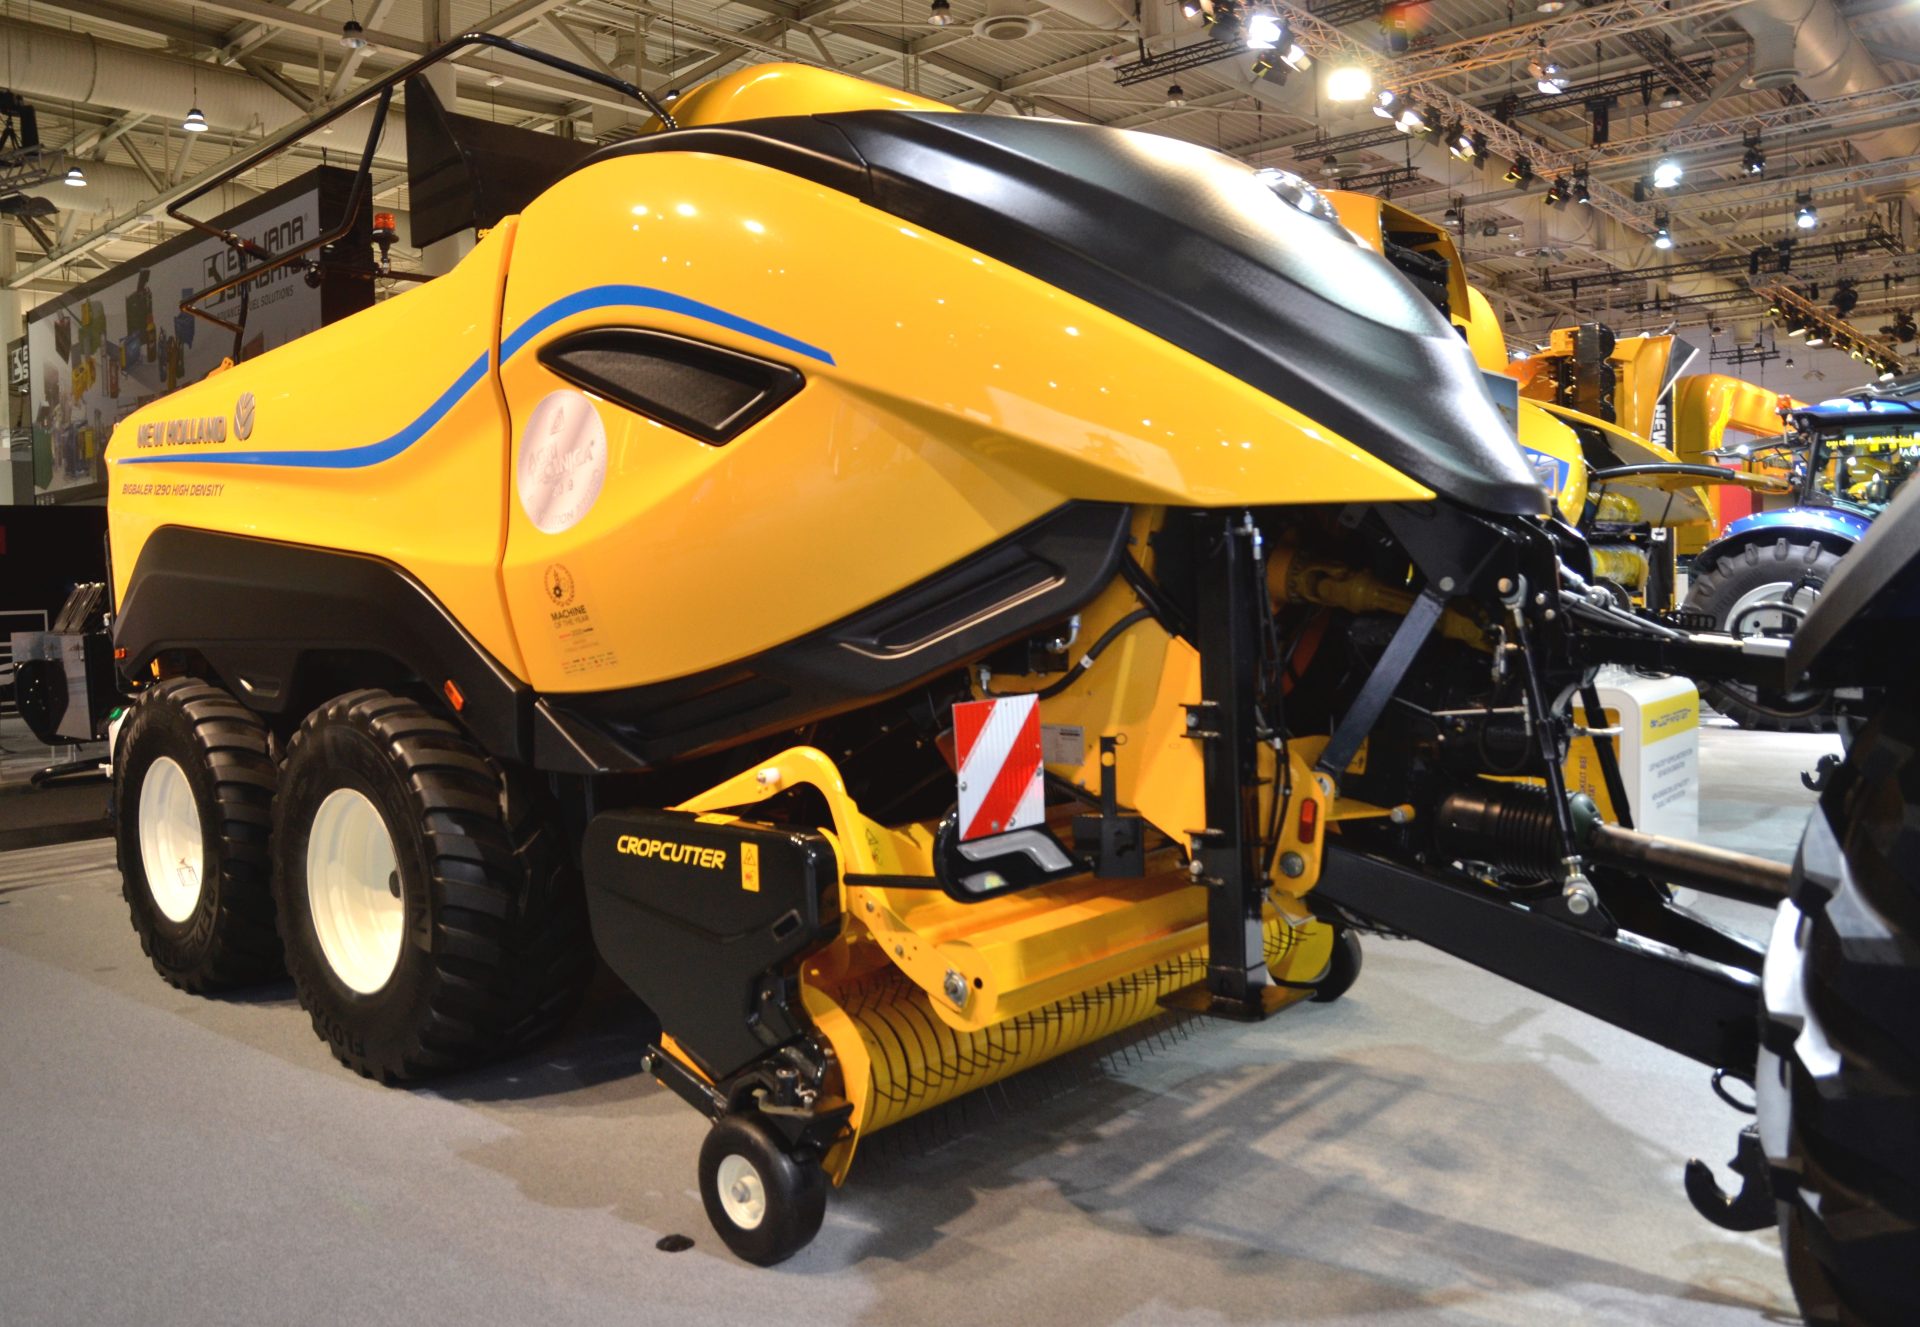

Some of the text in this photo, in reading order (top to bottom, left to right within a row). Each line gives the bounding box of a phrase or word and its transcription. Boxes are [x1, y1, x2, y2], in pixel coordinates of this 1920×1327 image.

[137, 416, 227, 448] NEW HOLLAND
[122, 484, 224, 496] BIGBALER 1290 HIGH DENSITY
[551, 605, 587, 621] MACHINE
[575, 614, 590, 624] YEAR
[616, 835, 727, 870] CROPCUTTER
